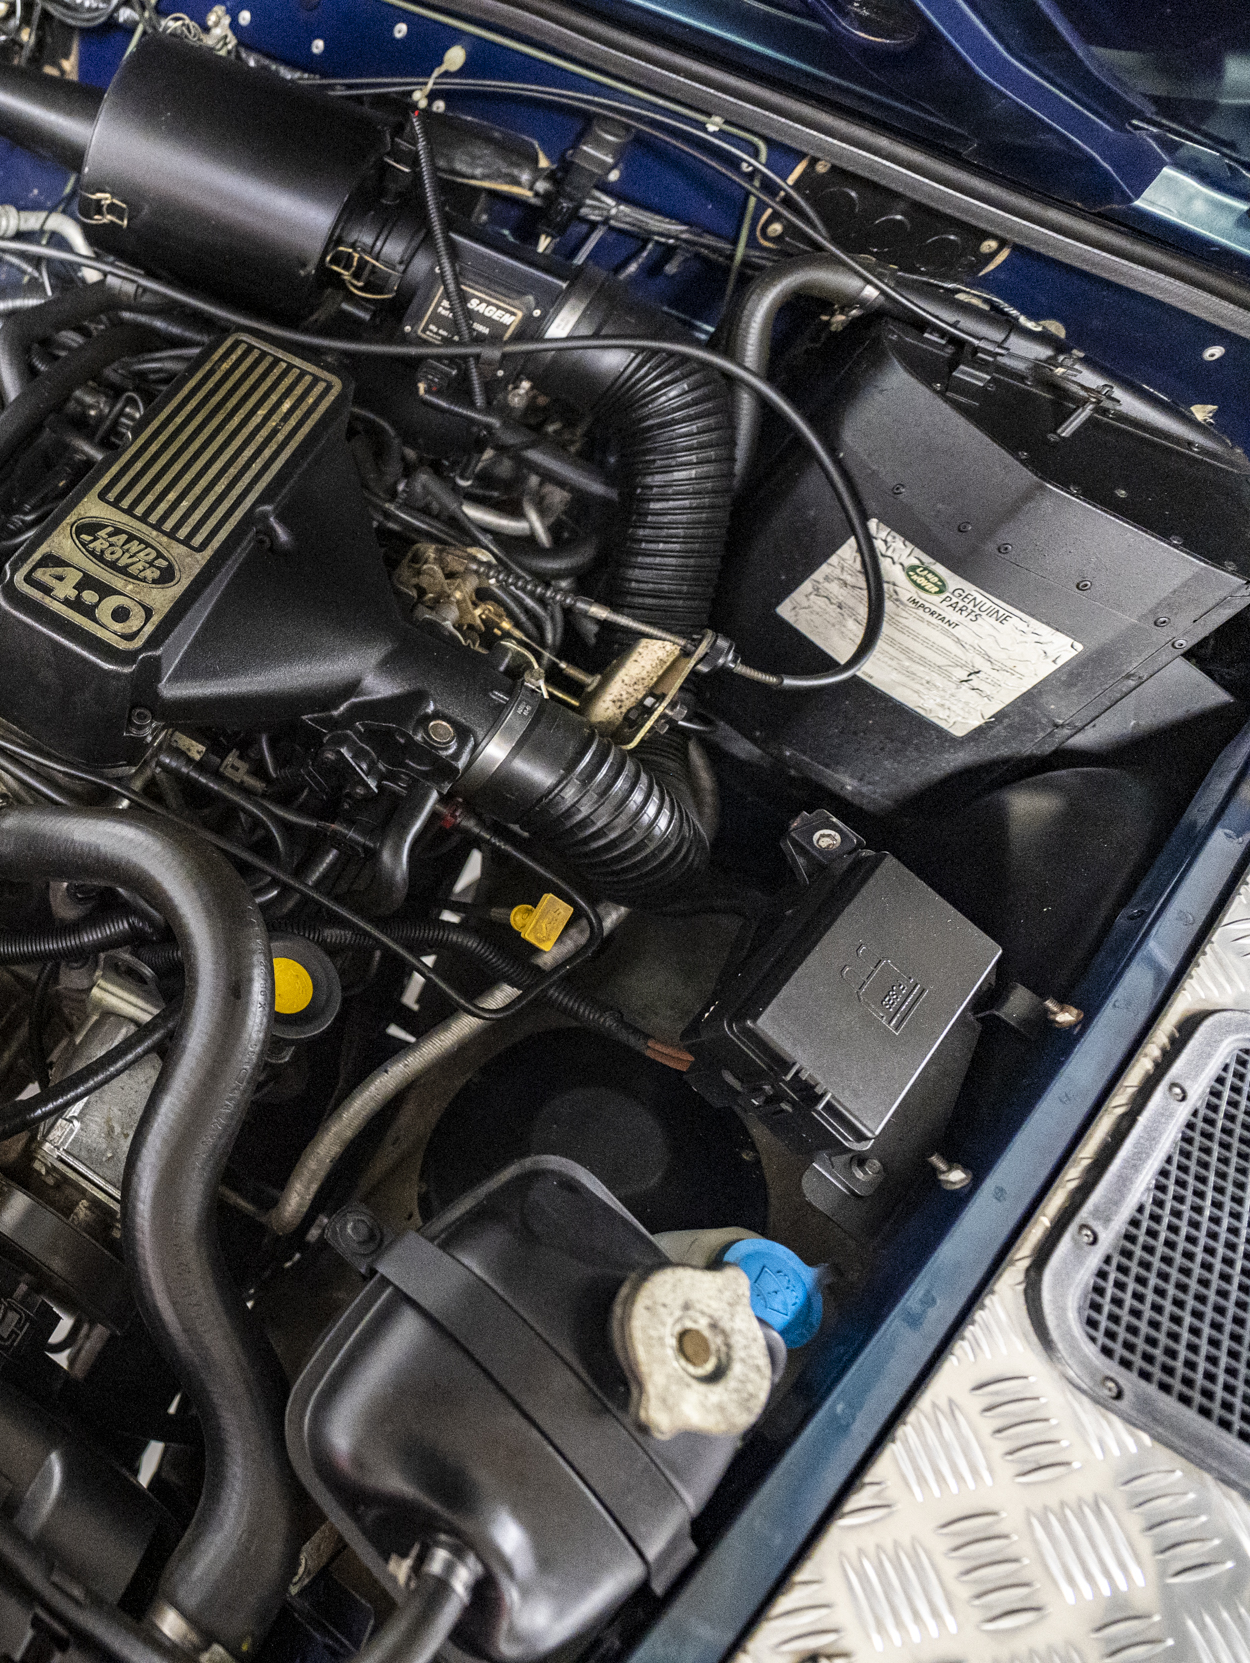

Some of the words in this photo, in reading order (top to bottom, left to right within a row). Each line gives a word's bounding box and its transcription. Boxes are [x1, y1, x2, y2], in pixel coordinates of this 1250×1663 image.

[468, 297, 514, 326] SAGEM
[86, 539, 160, 583] ROVER
[96, 526, 157, 562] LAND
[915, 565, 940, 584] LAND
[907, 595, 958, 631] IMPORTANT
[940, 593, 980, 624] PARTS
[952, 584, 1010, 627] GENUINE
